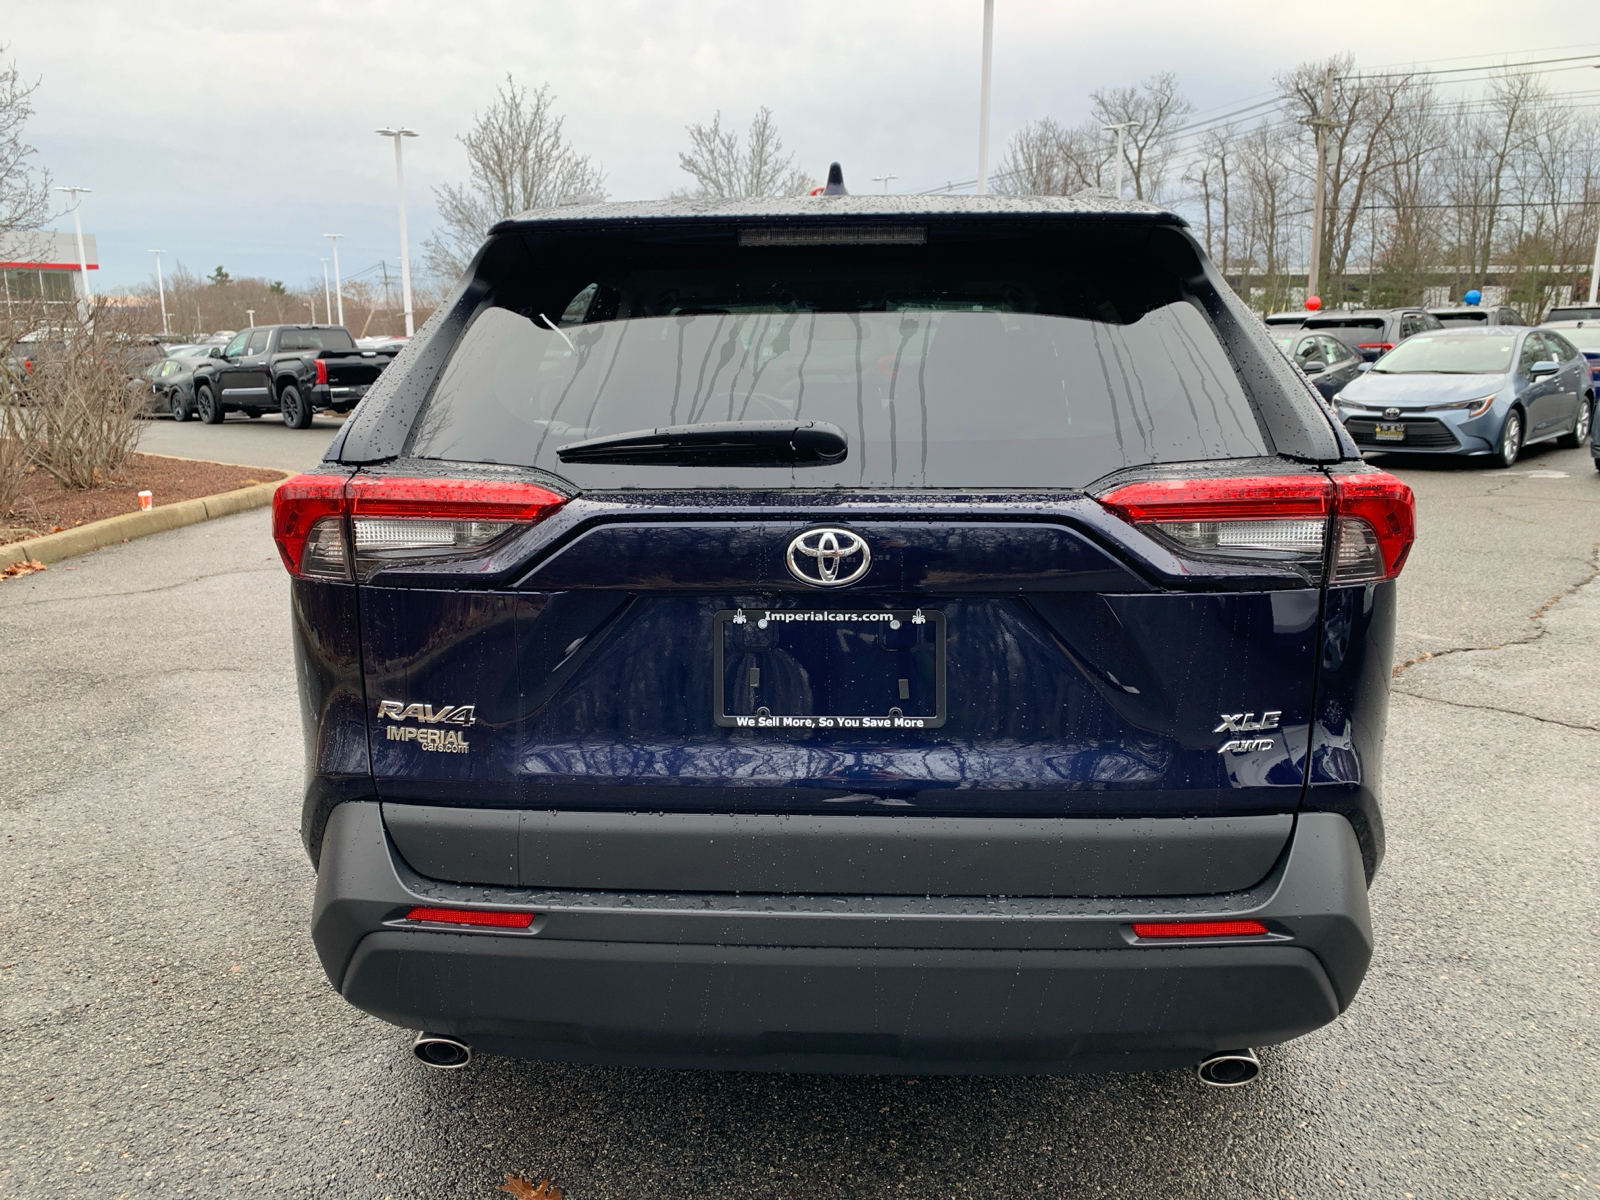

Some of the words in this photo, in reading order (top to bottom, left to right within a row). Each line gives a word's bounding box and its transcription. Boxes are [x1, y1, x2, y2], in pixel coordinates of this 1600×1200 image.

[765, 611, 894, 623] Imperialcars.com
[377, 700, 476, 727] RAV4
[736, 717, 755, 727] We
[758, 717, 780, 727] Sell
[783, 717, 816, 729] More,
[818, 717, 834, 727] So
[837, 717, 860, 727] You
[862, 718, 891, 728] Save
[894, 718, 924, 728] More
[1213, 711, 1282, 733] XLE
[386, 725, 469, 746] IMPERIAL
[421, 742, 469, 754] cars.com
[1217, 739, 1275, 754] AWD
